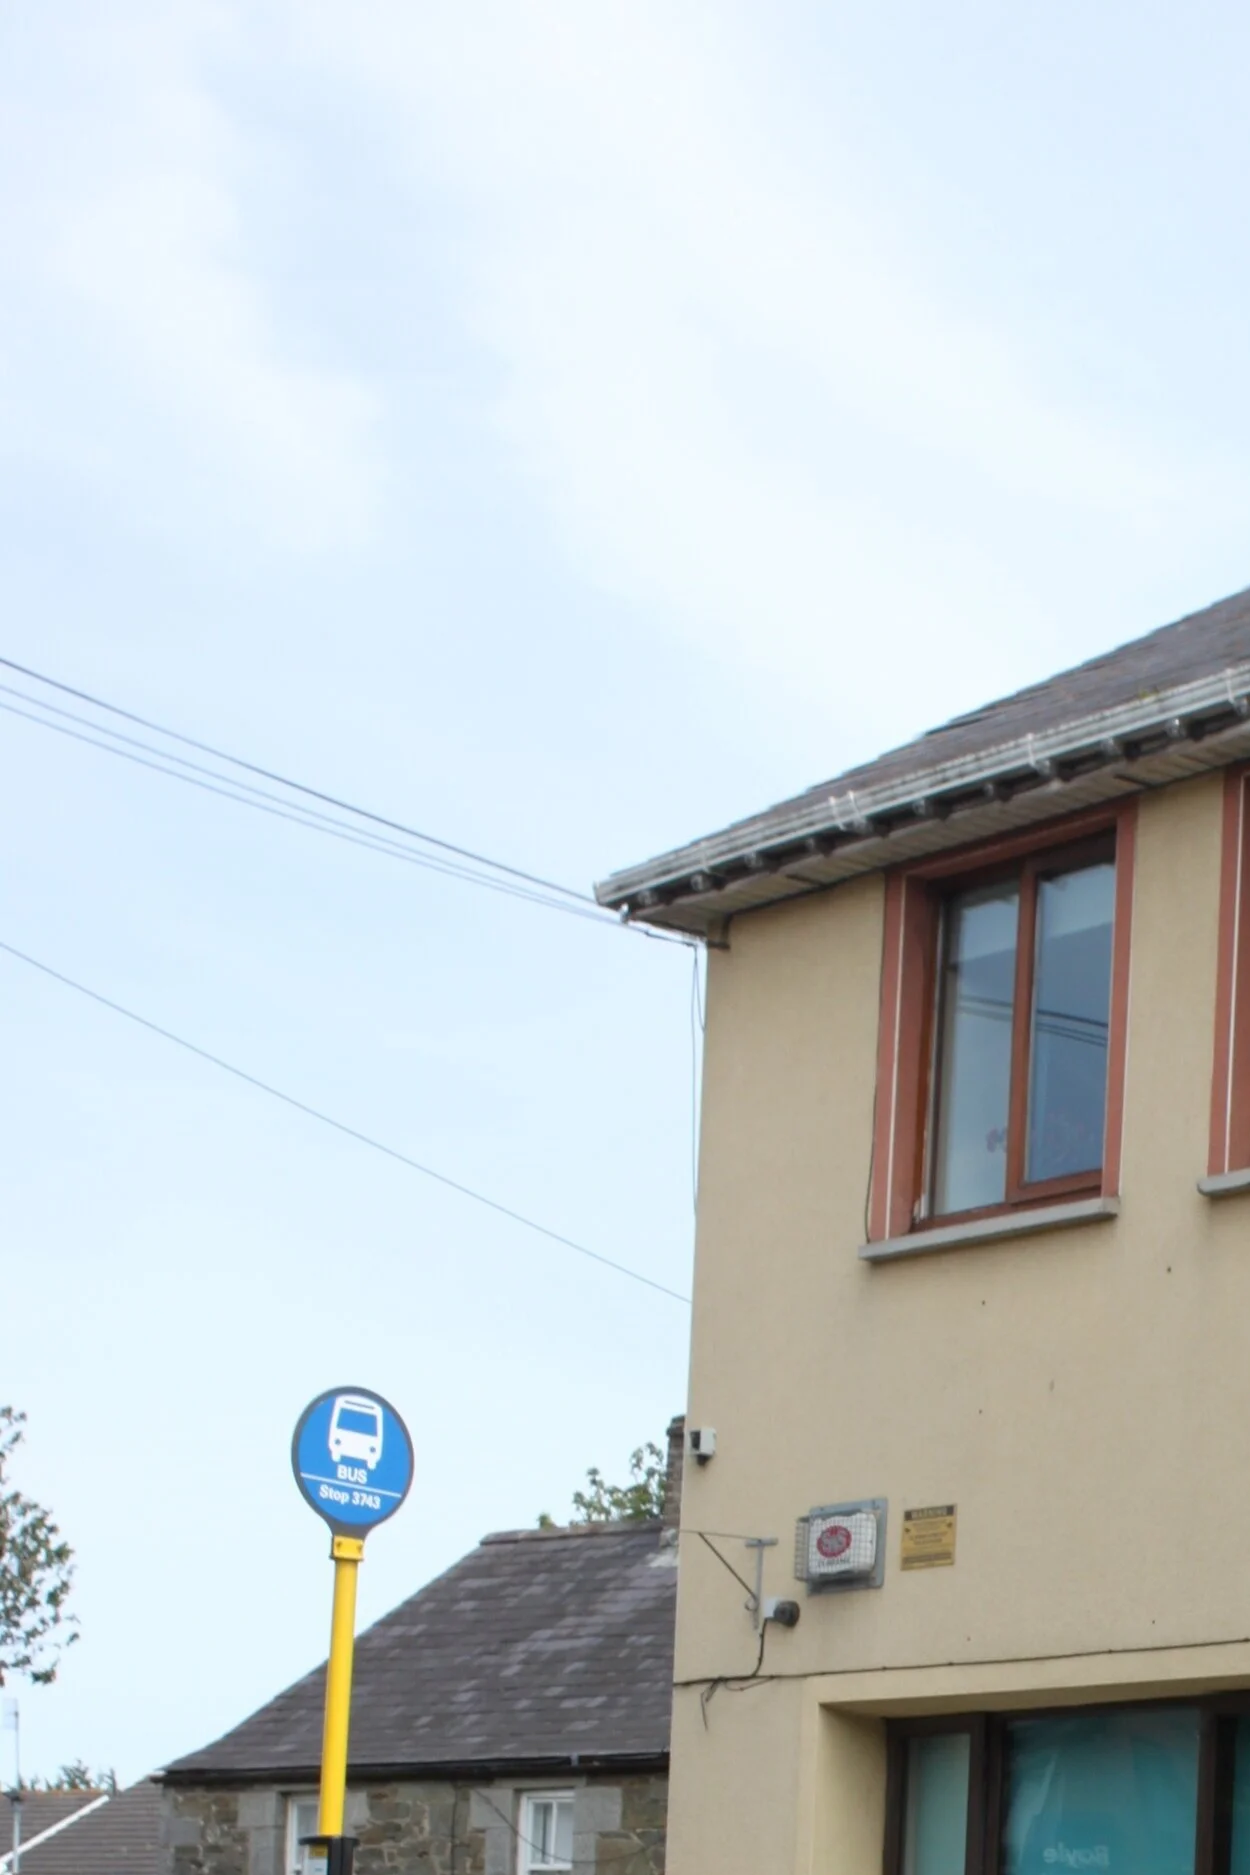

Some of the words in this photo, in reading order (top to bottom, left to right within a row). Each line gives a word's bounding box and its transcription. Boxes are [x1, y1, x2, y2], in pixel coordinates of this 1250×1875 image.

[337, 1464, 367, 1484] BUS
[319, 1484, 350, 1505] Stop
[352, 1490, 381, 1509] 3743
